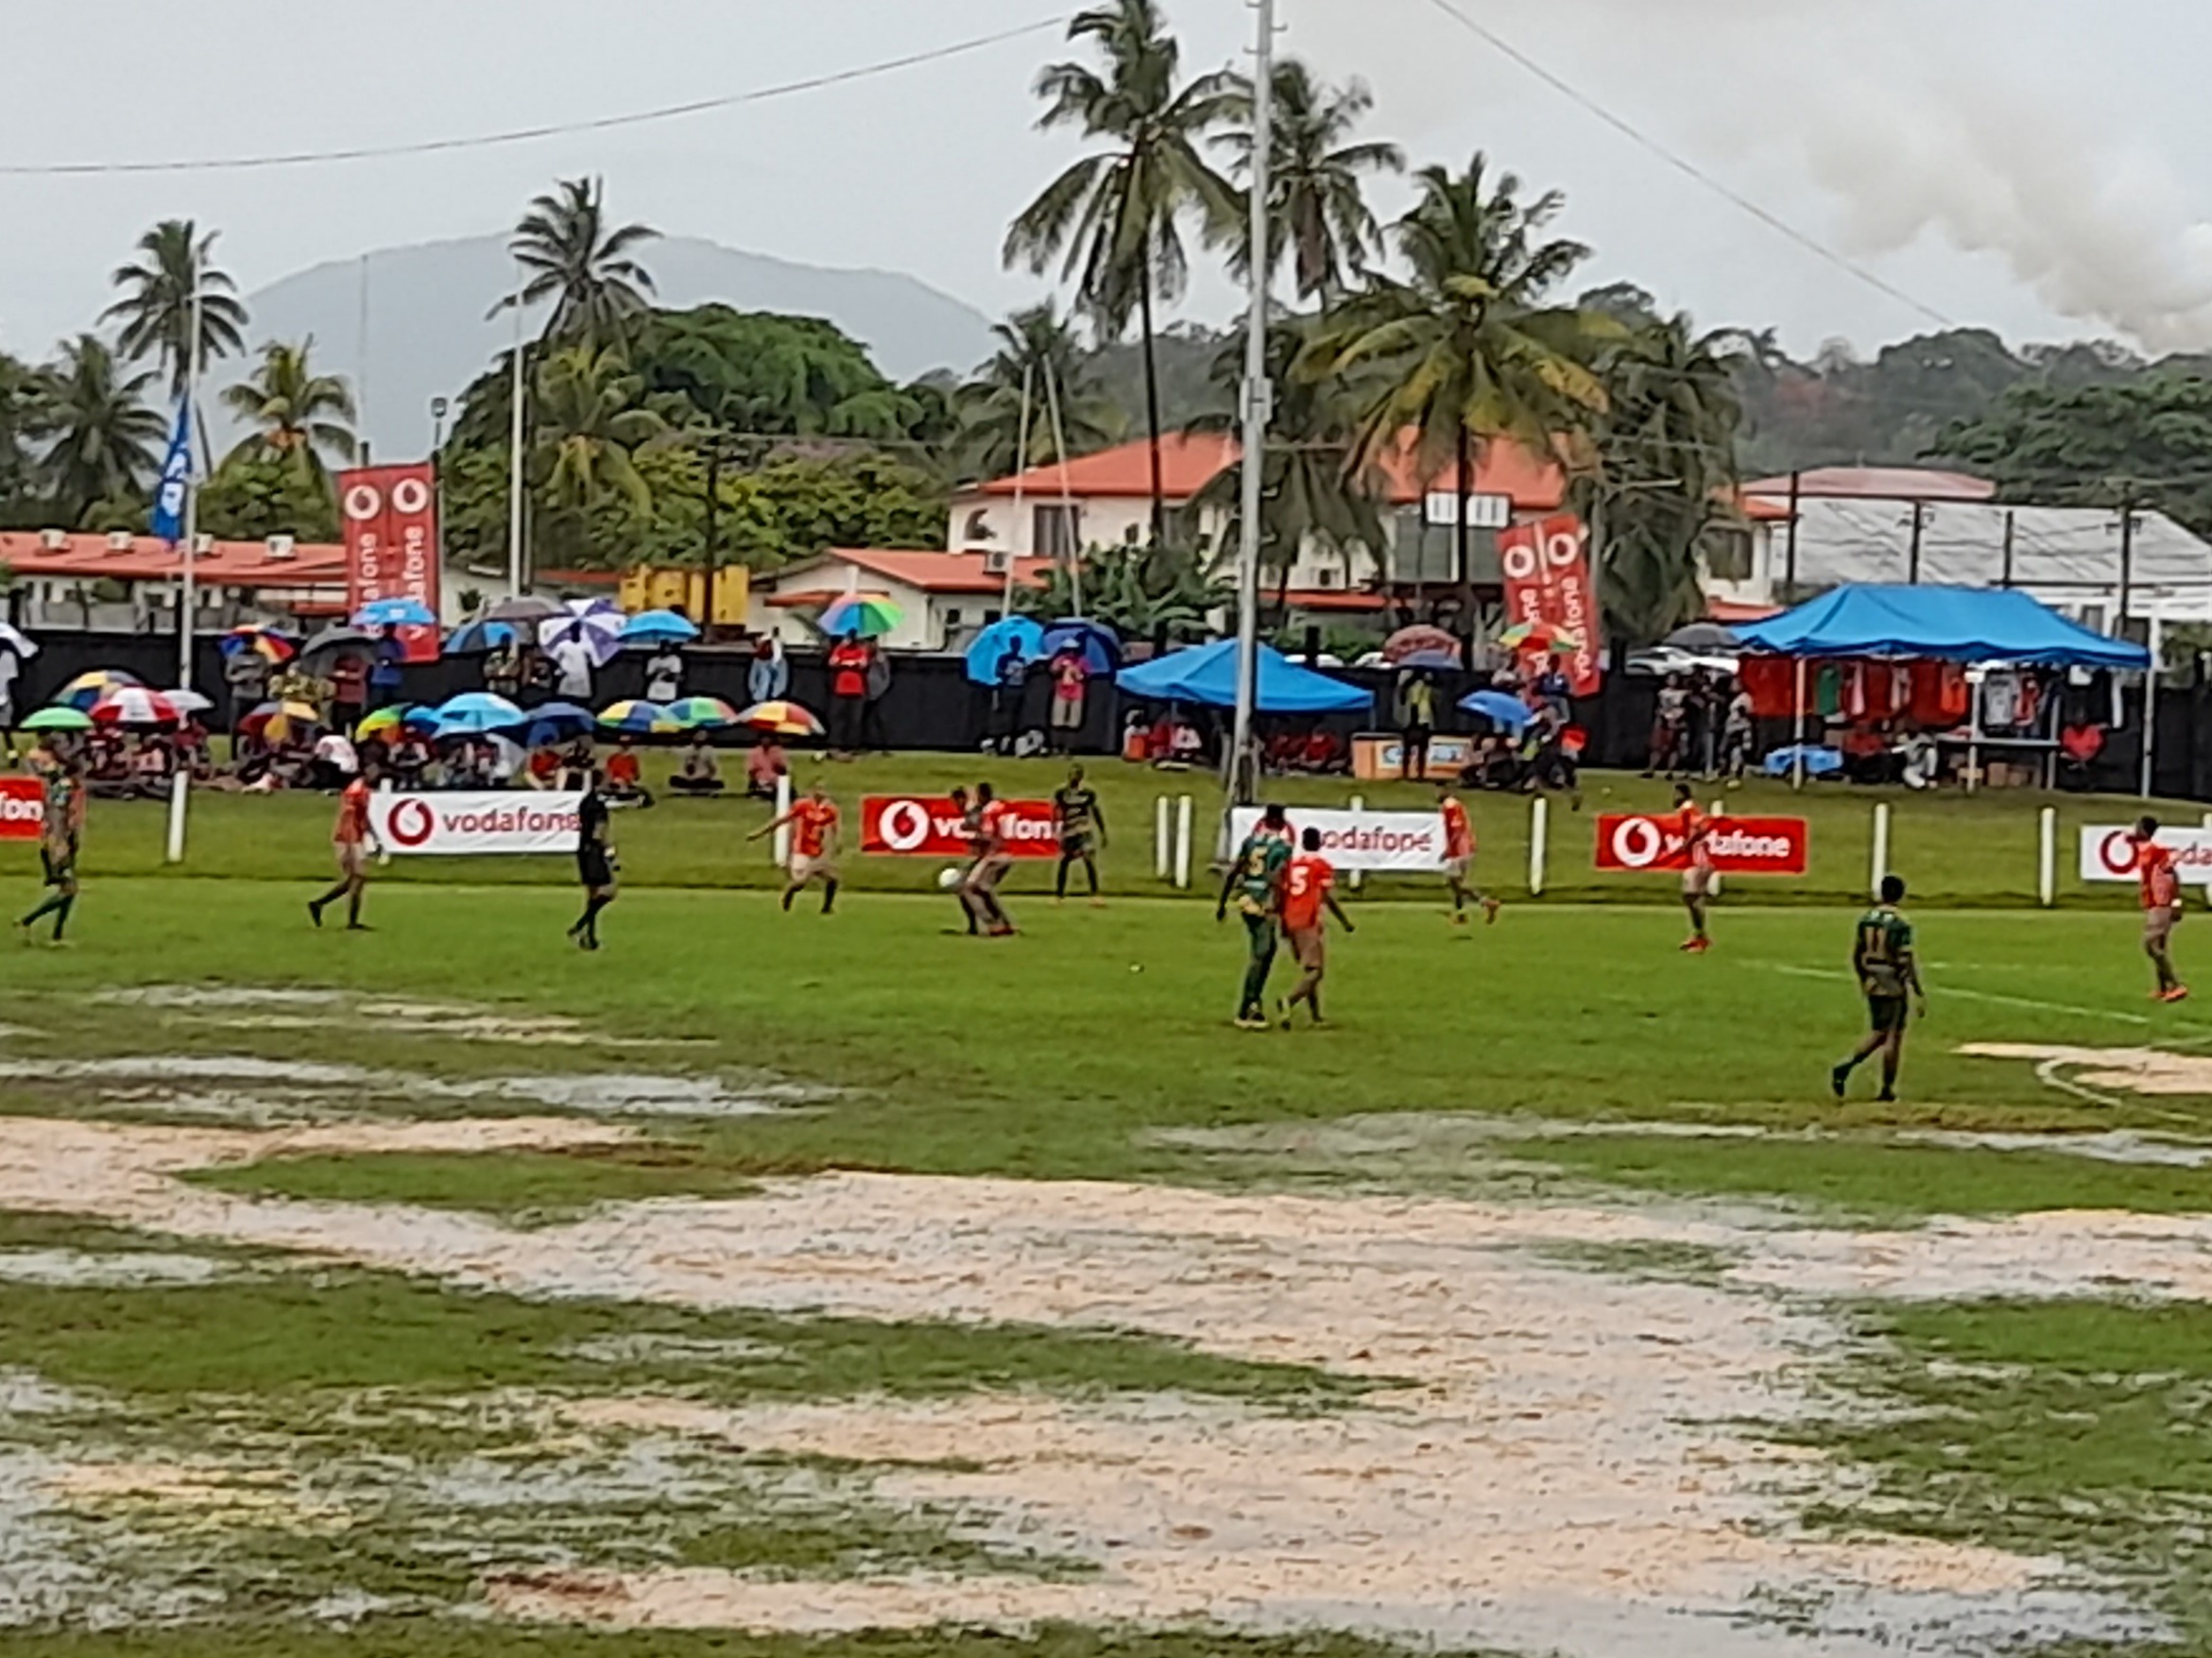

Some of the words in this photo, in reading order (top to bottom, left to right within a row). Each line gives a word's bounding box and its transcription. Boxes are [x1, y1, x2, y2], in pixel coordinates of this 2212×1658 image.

[443, 807, 582, 832] vodafone
[1321, 826, 1432, 851] odafone
[1248, 846, 1267, 876] 5
[1290, 865, 1309, 896] 5
[1864, 926, 1886, 953] 11
